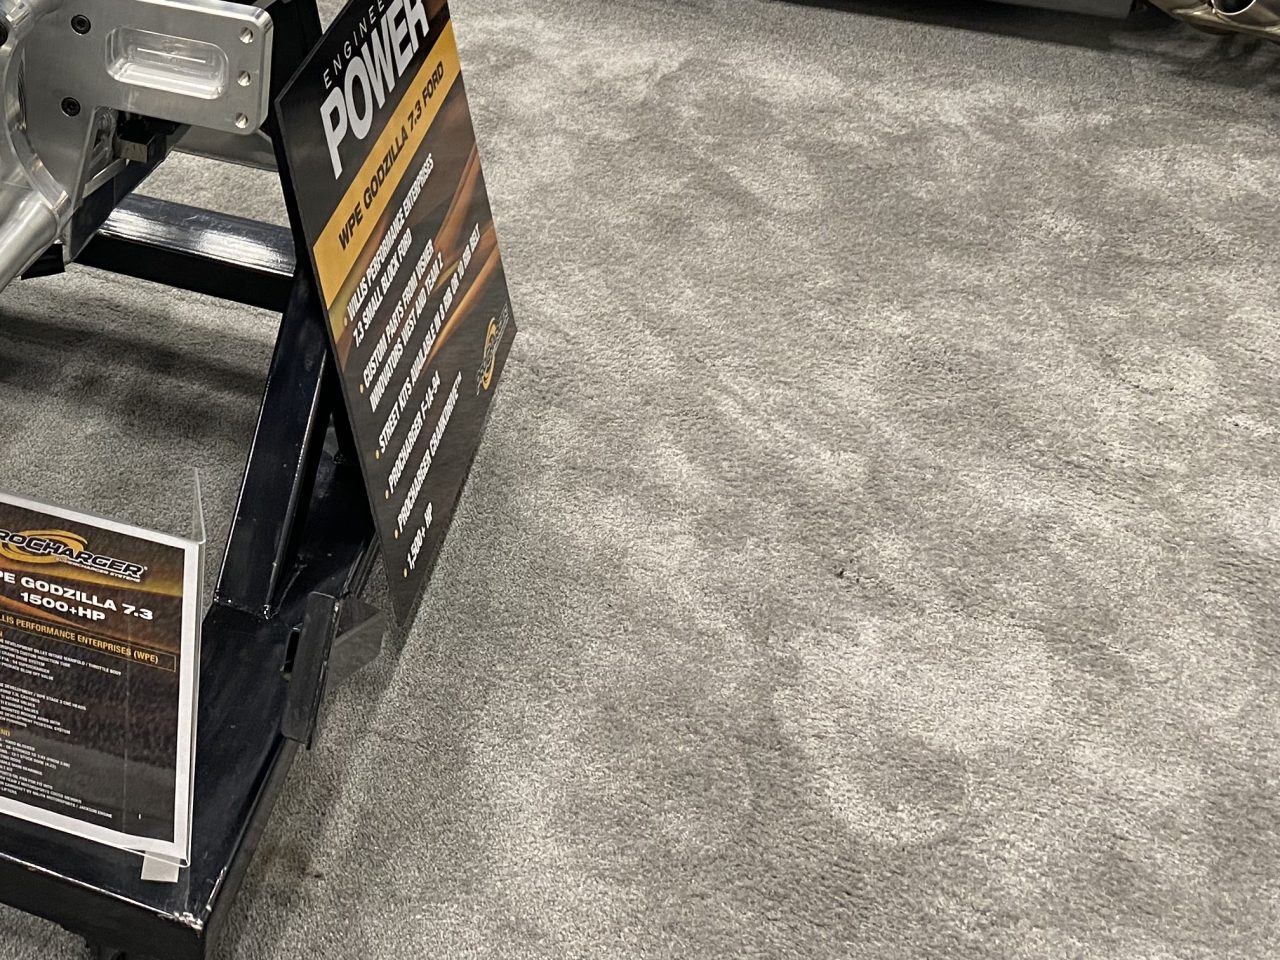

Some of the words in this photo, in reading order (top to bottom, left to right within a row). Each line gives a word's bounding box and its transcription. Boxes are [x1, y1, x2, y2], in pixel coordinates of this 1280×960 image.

[338, 199, 363, 253] WPE
[362, 121, 408, 212] GODZILLA
[407, 97, 422, 133] 7.3
[421, 59, 444, 108] FORD
[347, 274, 368, 323] WILLIS
[365, 205, 405, 288] PERFORMANCE
[402, 151, 433, 219] ENTERPRISES
[353, 318, 364, 349] 7.3
[362, 282, 383, 332] SMALL
[380, 250, 399, 296] BLOCK
[397, 225, 412, 263] FORD
[363, 331, 387, 390] CUSTOM
[385, 299, 403, 344] PARTS
[401, 270, 417, 310] FROM
[369, 334, 403, 414] INNOVATORS
[400, 306, 416, 348] WEST
[414, 284, 427, 319] AND
[424, 258, 439, 297] TEAM
[378, 399, 400, 456] STREET
[398, 374, 412, 413] KITS
[409, 321, 436, 387] AVAILABLE
[388, 407, 423, 497] PROCHARGER
[397, 445, 431, 537] PROCHARGER
[407, 517, 426, 576] 1,500+
[424, 498, 434, 531] HP
[16, 617, 74, 640] PERFORMANCE
[77, 633, 131, 656] ENTERPRISES
[133, 648, 158, 663] (WPE)
[20, 575, 116, 611] GODZILLA
[121, 602, 153, 621] 7.3
[20, 590, 105, 623] 1500+HP
